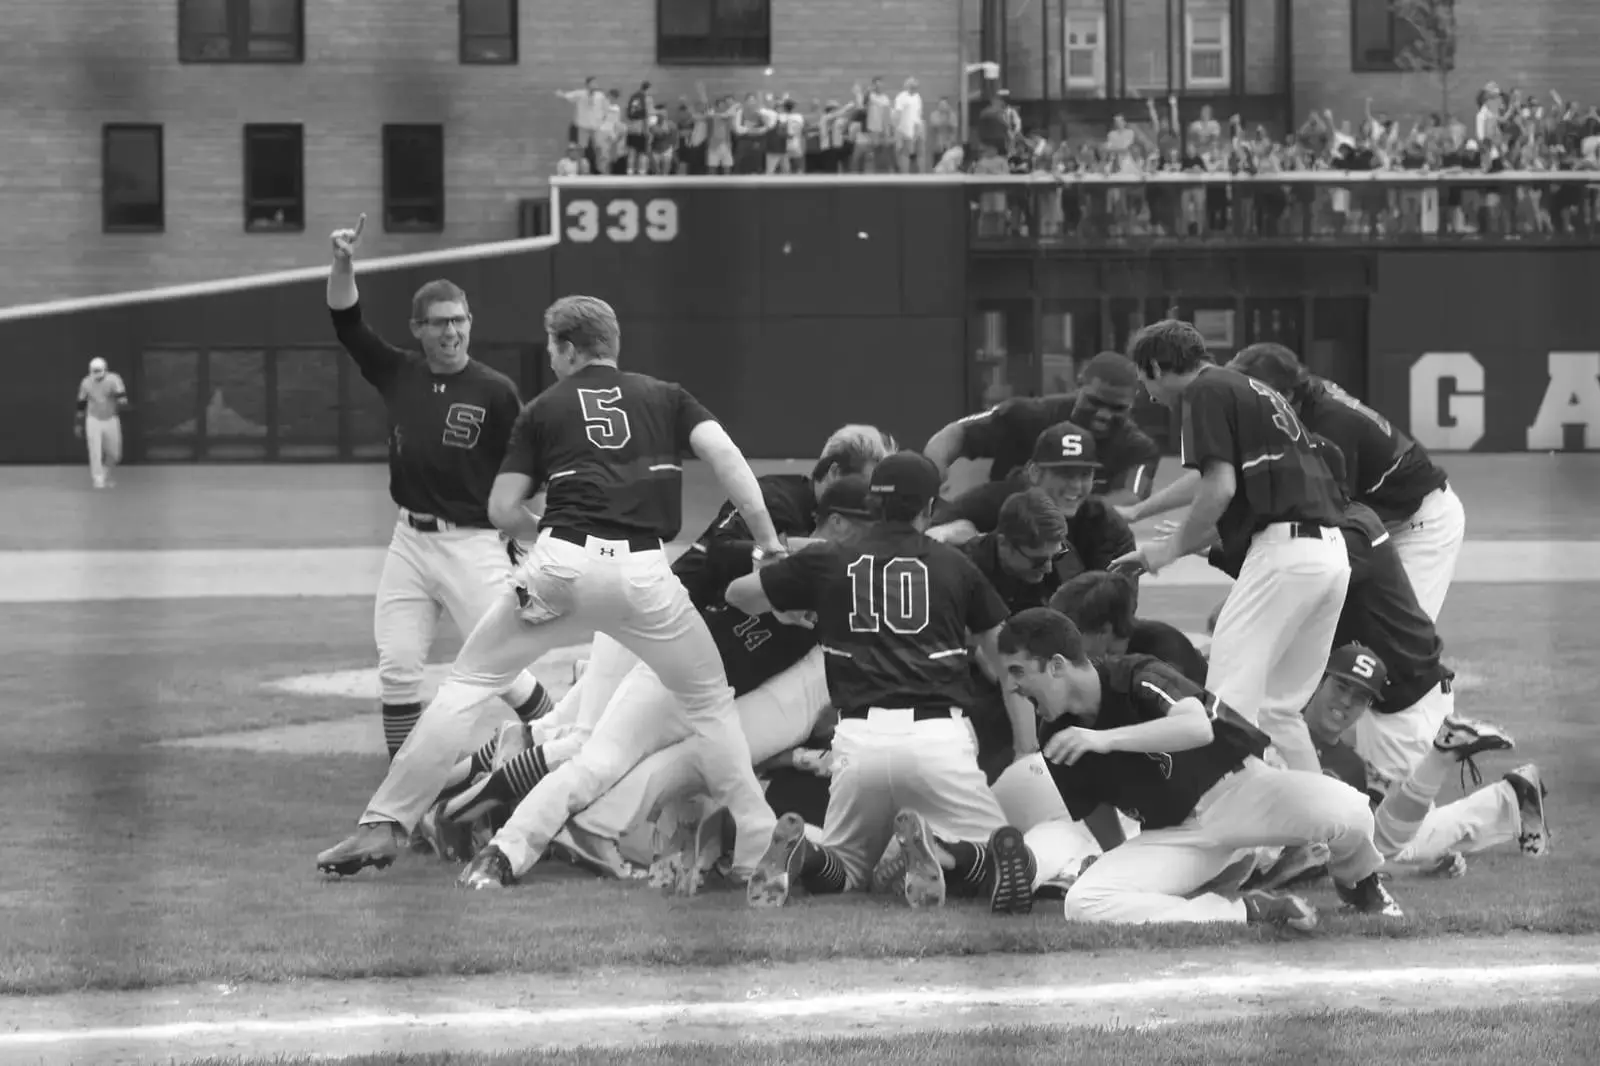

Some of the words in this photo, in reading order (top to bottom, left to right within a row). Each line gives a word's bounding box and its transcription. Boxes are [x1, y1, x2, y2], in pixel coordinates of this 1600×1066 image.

[565, 199, 678, 242] 339
[577, 386, 631, 449] 5
[1409, 352, 1600, 451] GA
[442, 403, 486, 449] S
[1062, 434, 1082, 456] S
[847, 554, 930, 634] 10
[733, 615, 772, 652] 14
[1352, 654, 1376, 678] S
